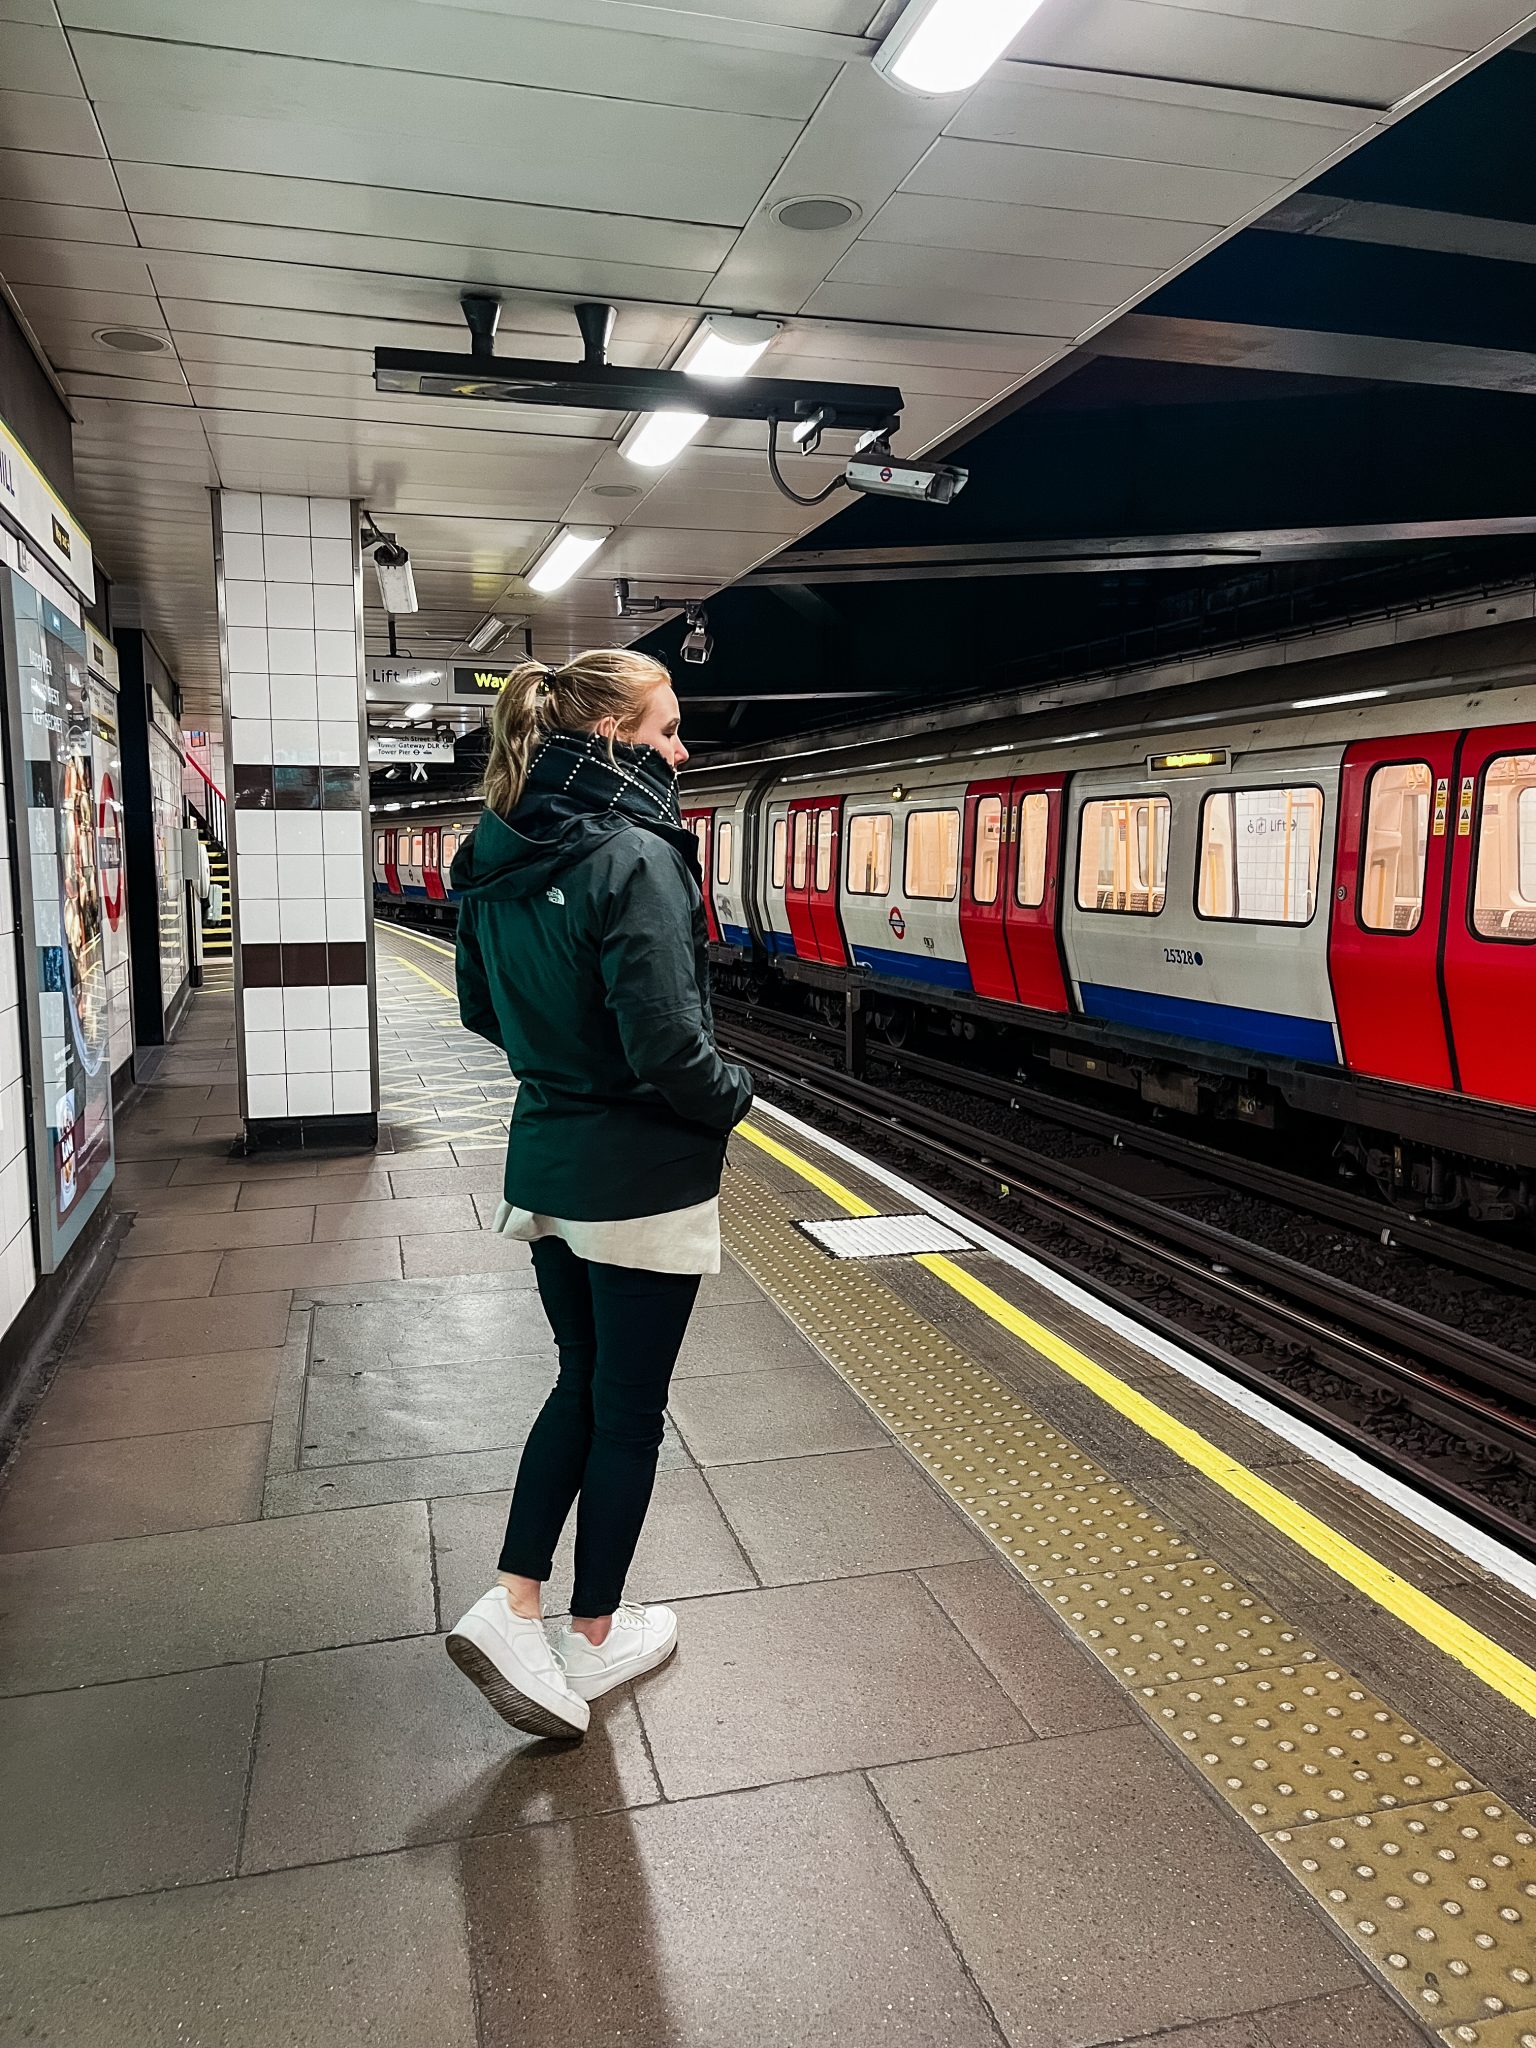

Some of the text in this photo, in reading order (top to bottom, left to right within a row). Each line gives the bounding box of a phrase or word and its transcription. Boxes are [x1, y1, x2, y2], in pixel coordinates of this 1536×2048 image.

[372, 669, 400, 683] Lift
[474, 672, 508, 692] Way
[398, 742, 425, 750] Gateway
[1271, 819, 1287, 832] Lift
[1163, 947, 1194, 965] 25328
